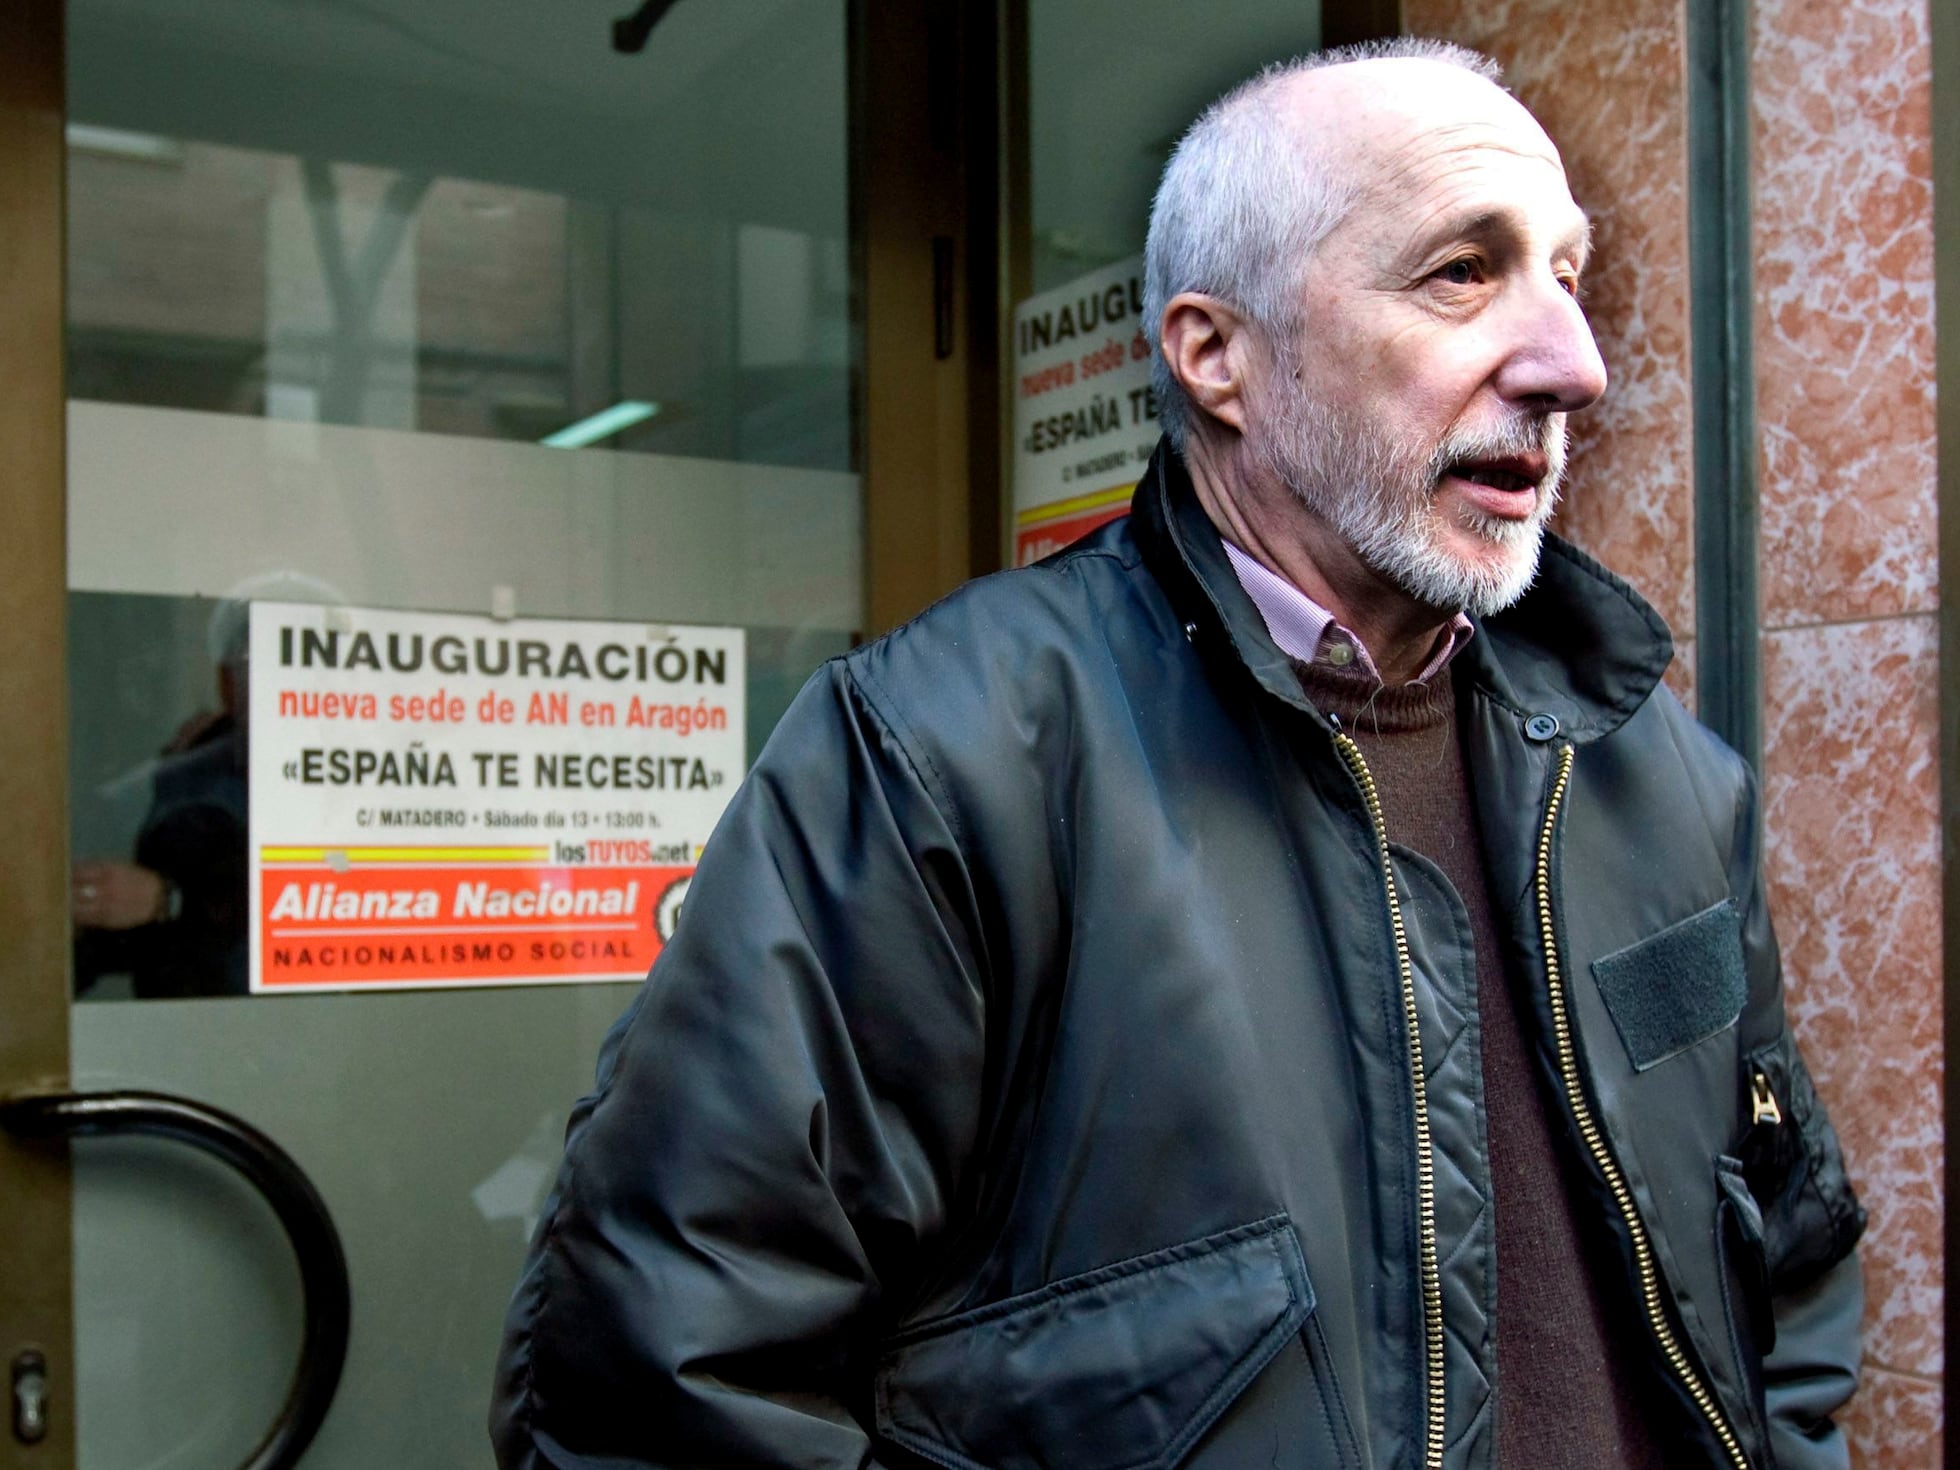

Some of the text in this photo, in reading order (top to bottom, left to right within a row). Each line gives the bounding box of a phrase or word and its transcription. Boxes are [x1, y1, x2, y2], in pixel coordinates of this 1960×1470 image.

[280, 627, 725, 684] INAUGURACIÓN
[279, 688, 727, 737] nueva sede de AN en Aragón
[282, 741, 724, 790] «ESPAÑA TE NECESITA»
[356, 809, 375, 828] C/
[380, 809, 466, 828] MATADERO
[572, 811, 588, 828] 13
[605, 811, 644, 829] 13:00
[269, 882, 440, 920] Alianza
[453, 881, 639, 918] Nacional
[273, 941, 633, 967] NACIONALISMO SOCIAL
